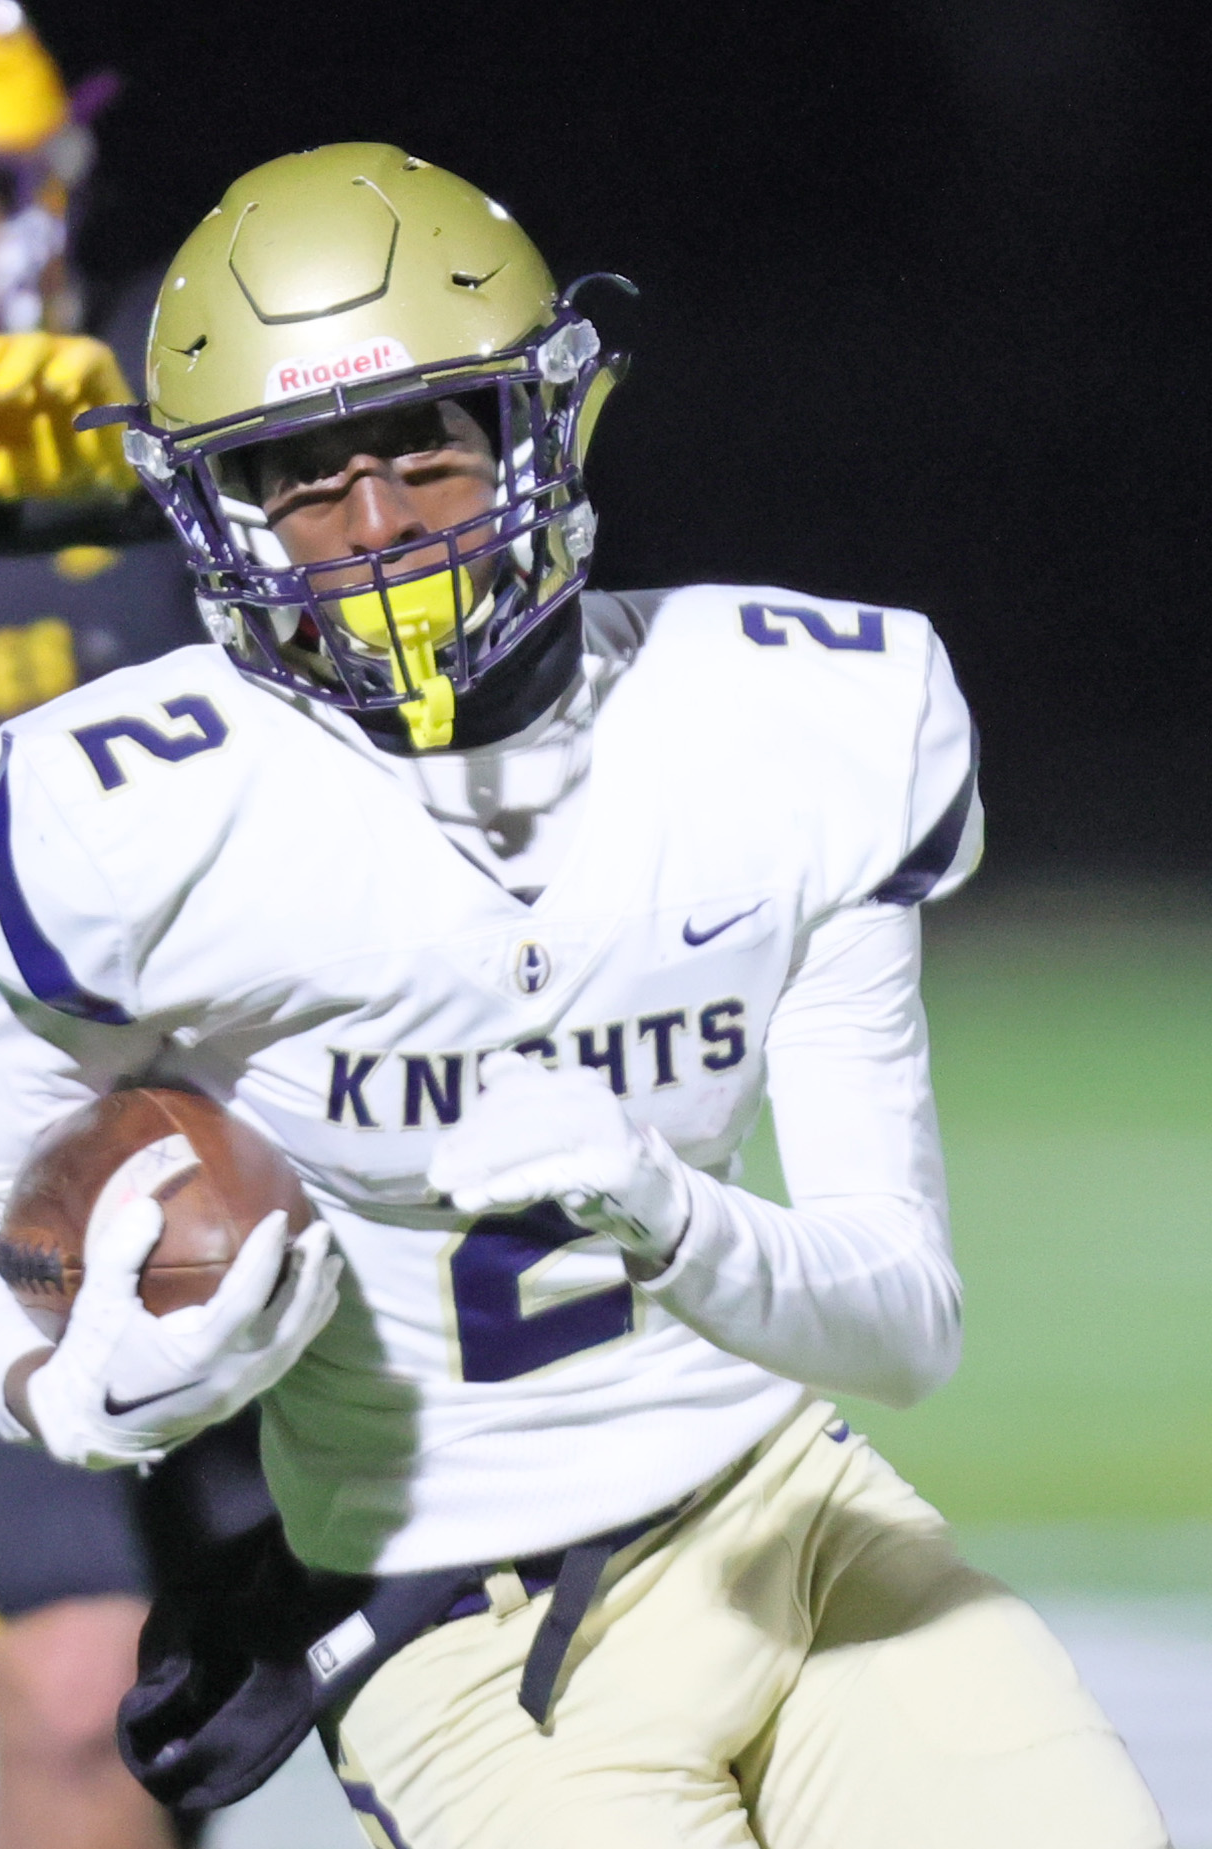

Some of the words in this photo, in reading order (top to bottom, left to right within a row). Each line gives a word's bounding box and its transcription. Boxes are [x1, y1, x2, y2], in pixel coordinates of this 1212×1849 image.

[739, 602, 887, 653] 2
[69, 692, 234, 795] 2
[325, 997, 749, 1132] KNHTS
[437, 1199, 645, 1383] 2
